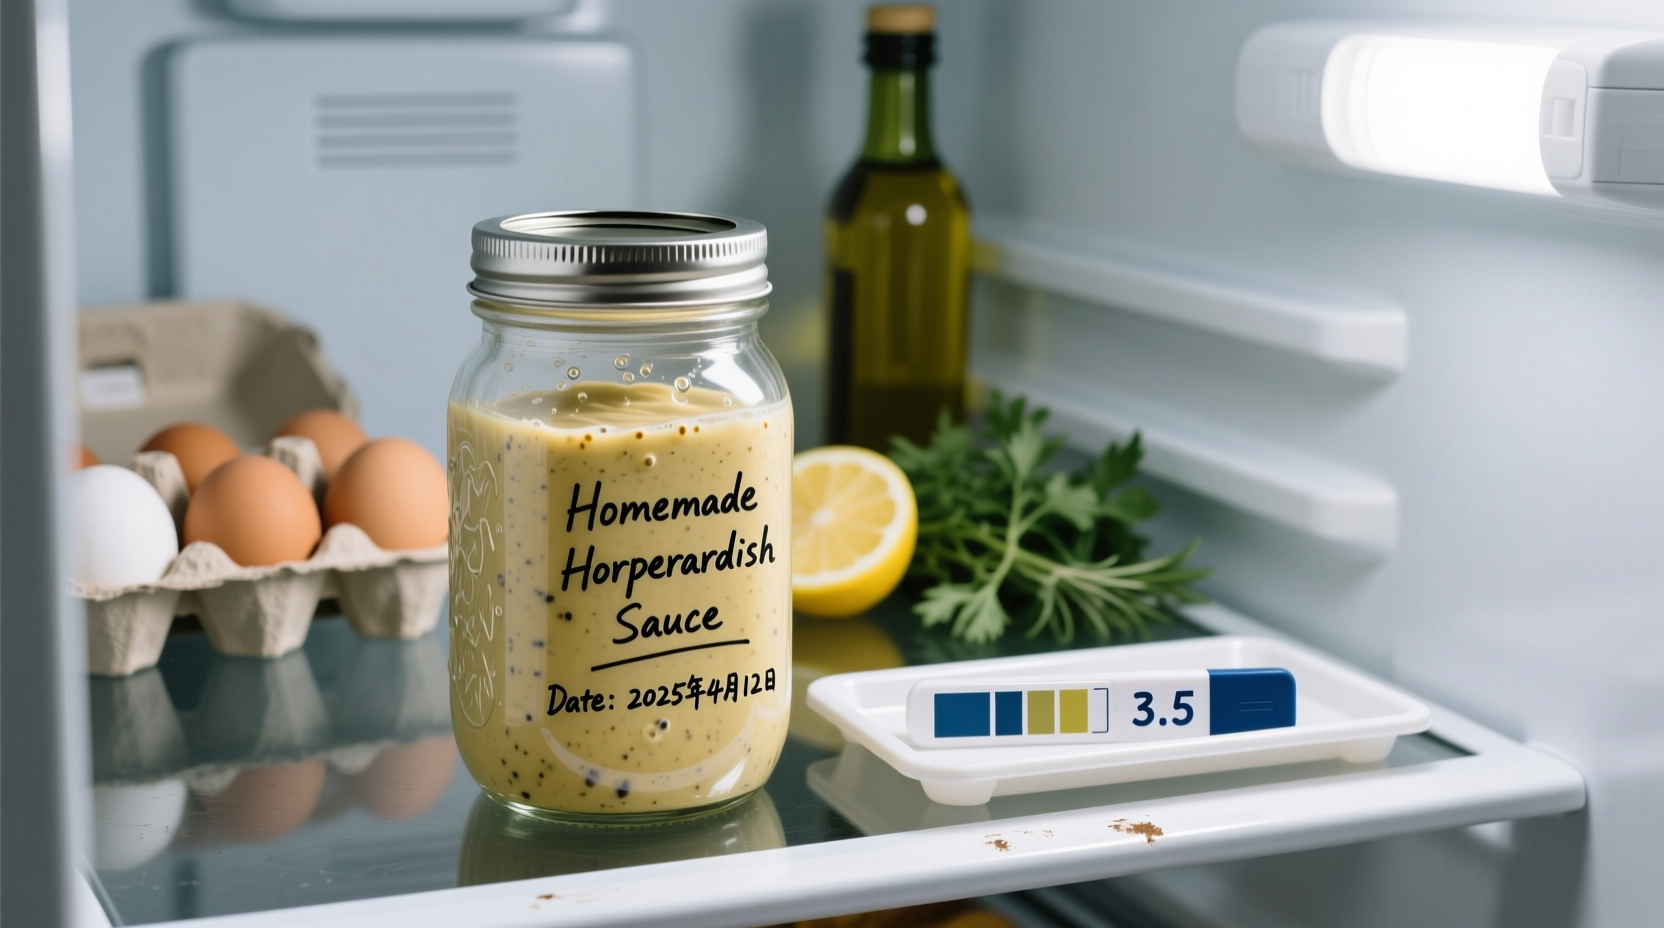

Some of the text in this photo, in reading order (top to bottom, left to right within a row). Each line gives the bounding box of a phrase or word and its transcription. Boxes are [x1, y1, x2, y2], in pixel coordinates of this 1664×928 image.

[566, 470, 758, 532] Homemade
[561, 524, 776, 599] Horperardish
[612, 602, 723, 645] Sauce
[546, 668, 776, 716] Date: 2025年4月12日
[1131, 690, 1195, 727] 3.5
